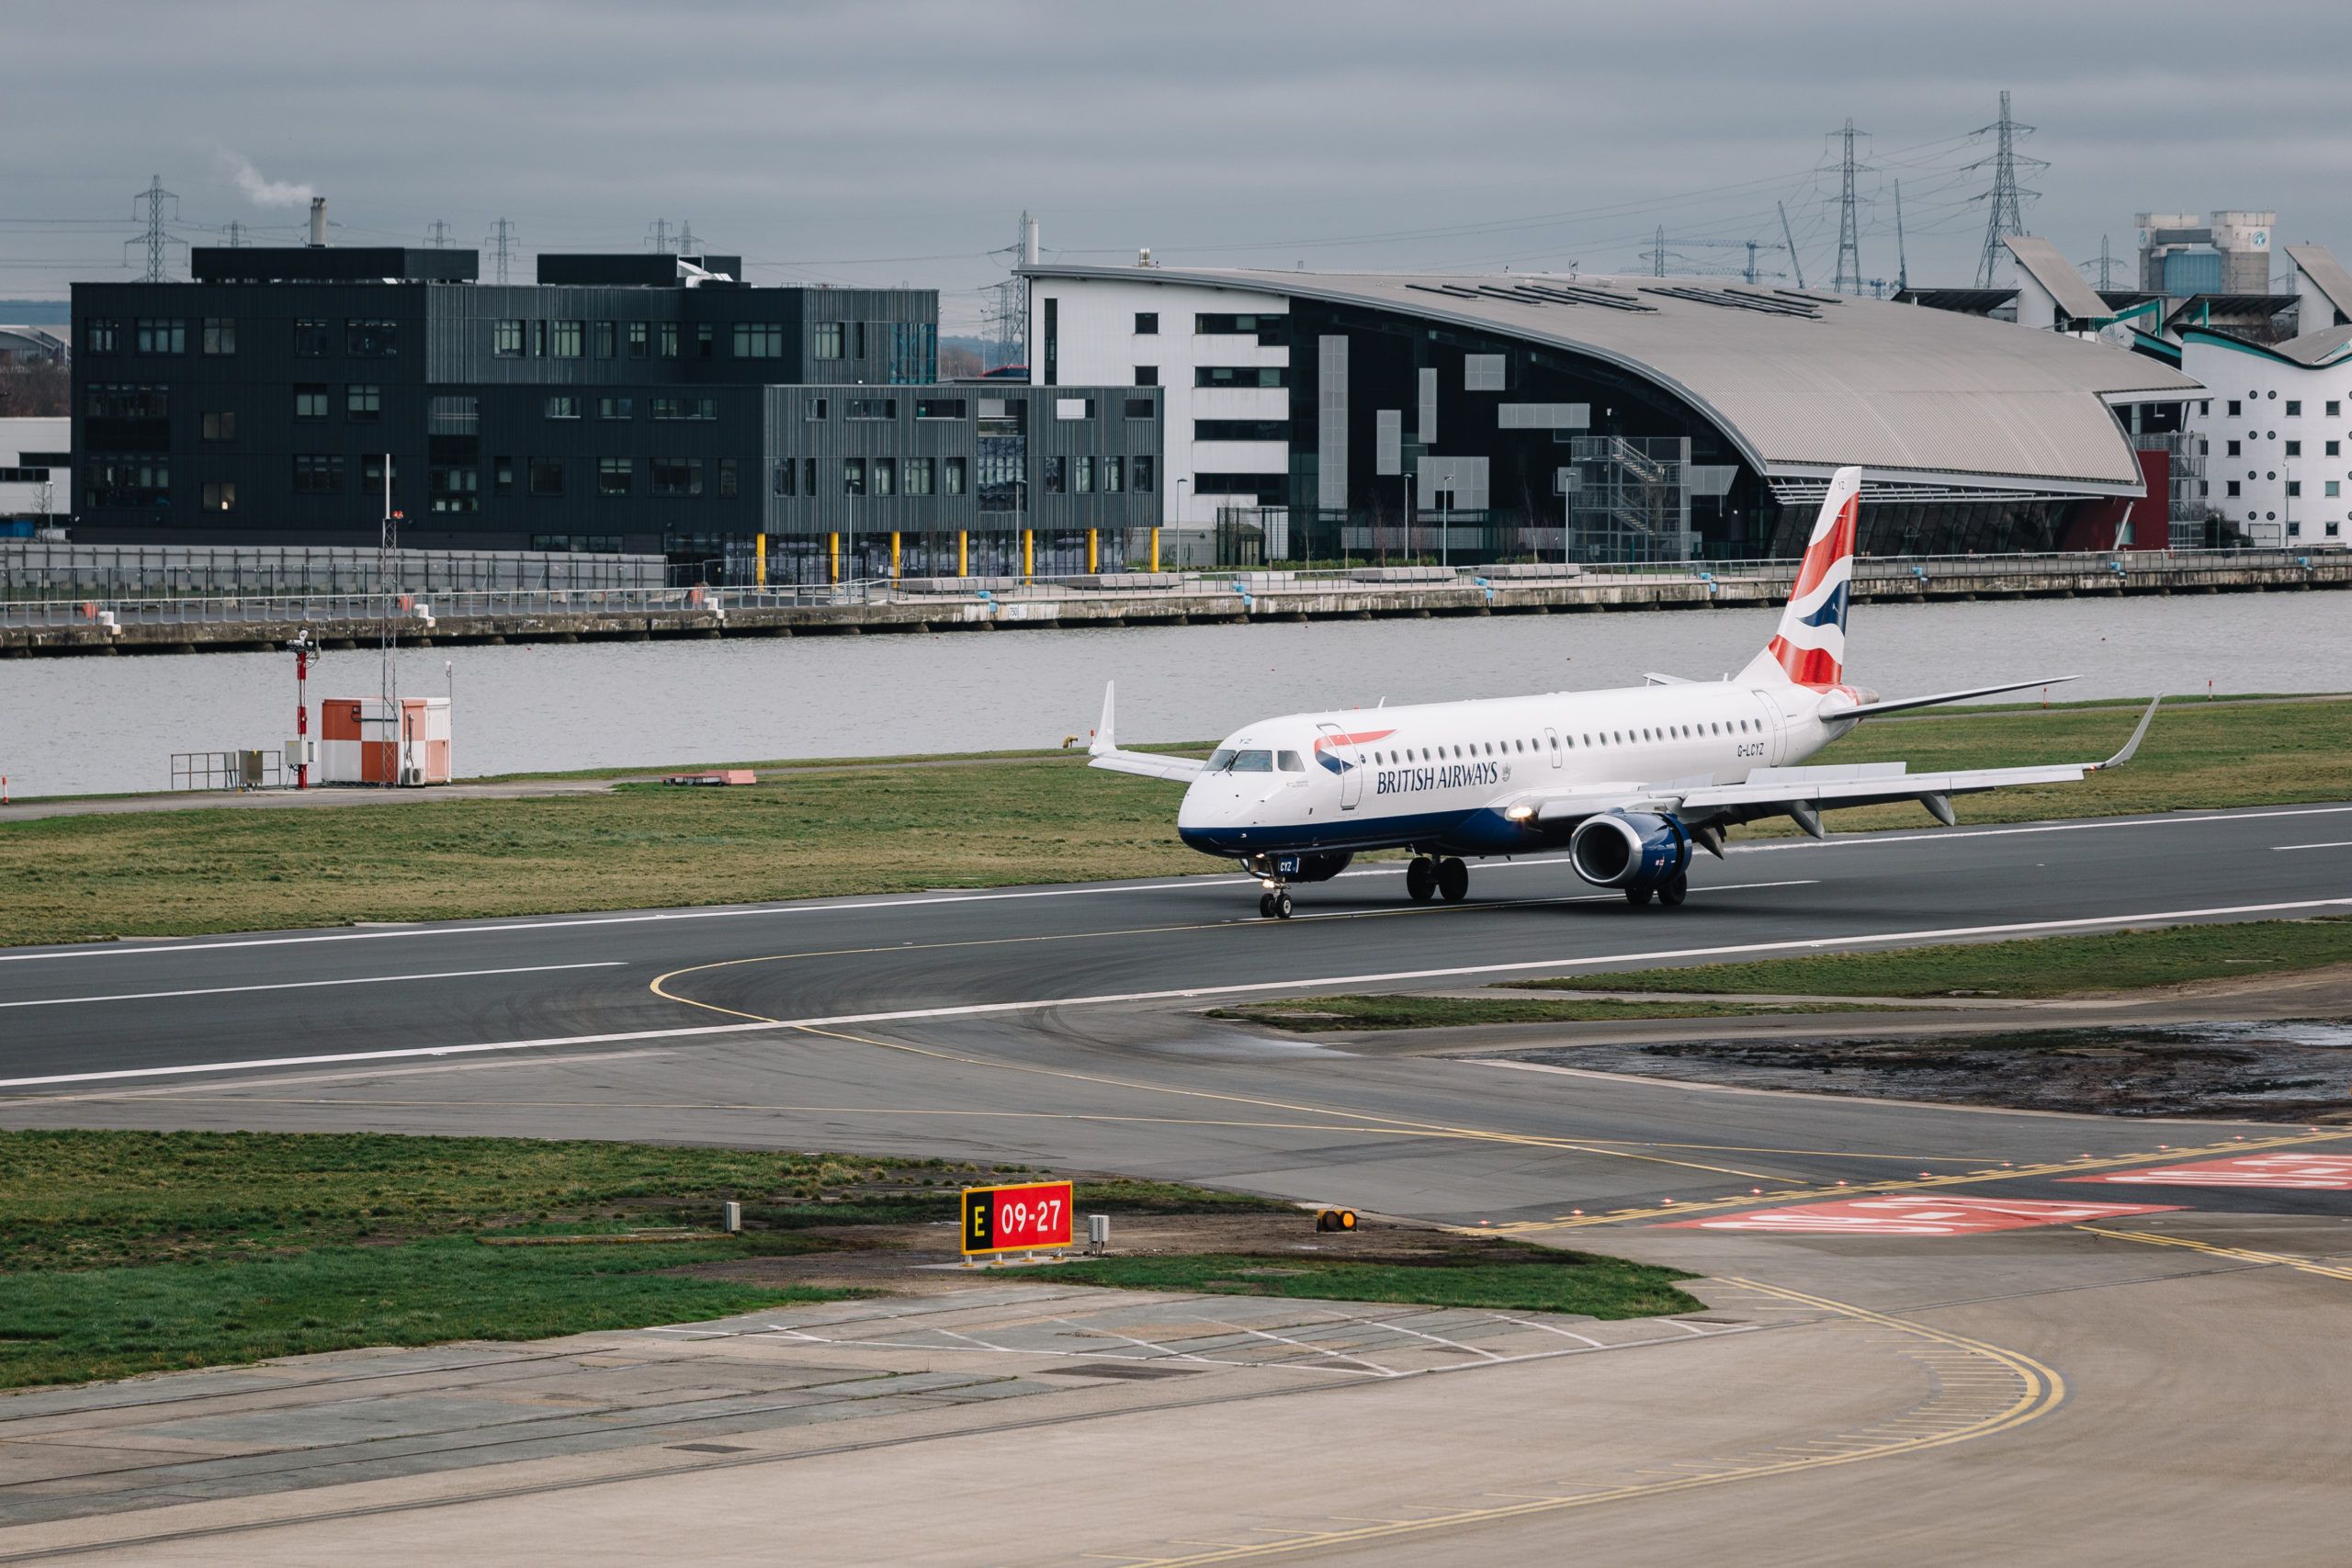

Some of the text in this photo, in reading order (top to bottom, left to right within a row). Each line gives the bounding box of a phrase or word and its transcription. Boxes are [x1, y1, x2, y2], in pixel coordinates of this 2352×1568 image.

[1737, 742, 1764, 758] G-LCYZ
[1376, 761, 1498, 795] BRITISH AIRWAYS
[1280, 862, 1292, 872] CYZ
[974, 1200, 1061, 1236] E 09-27
